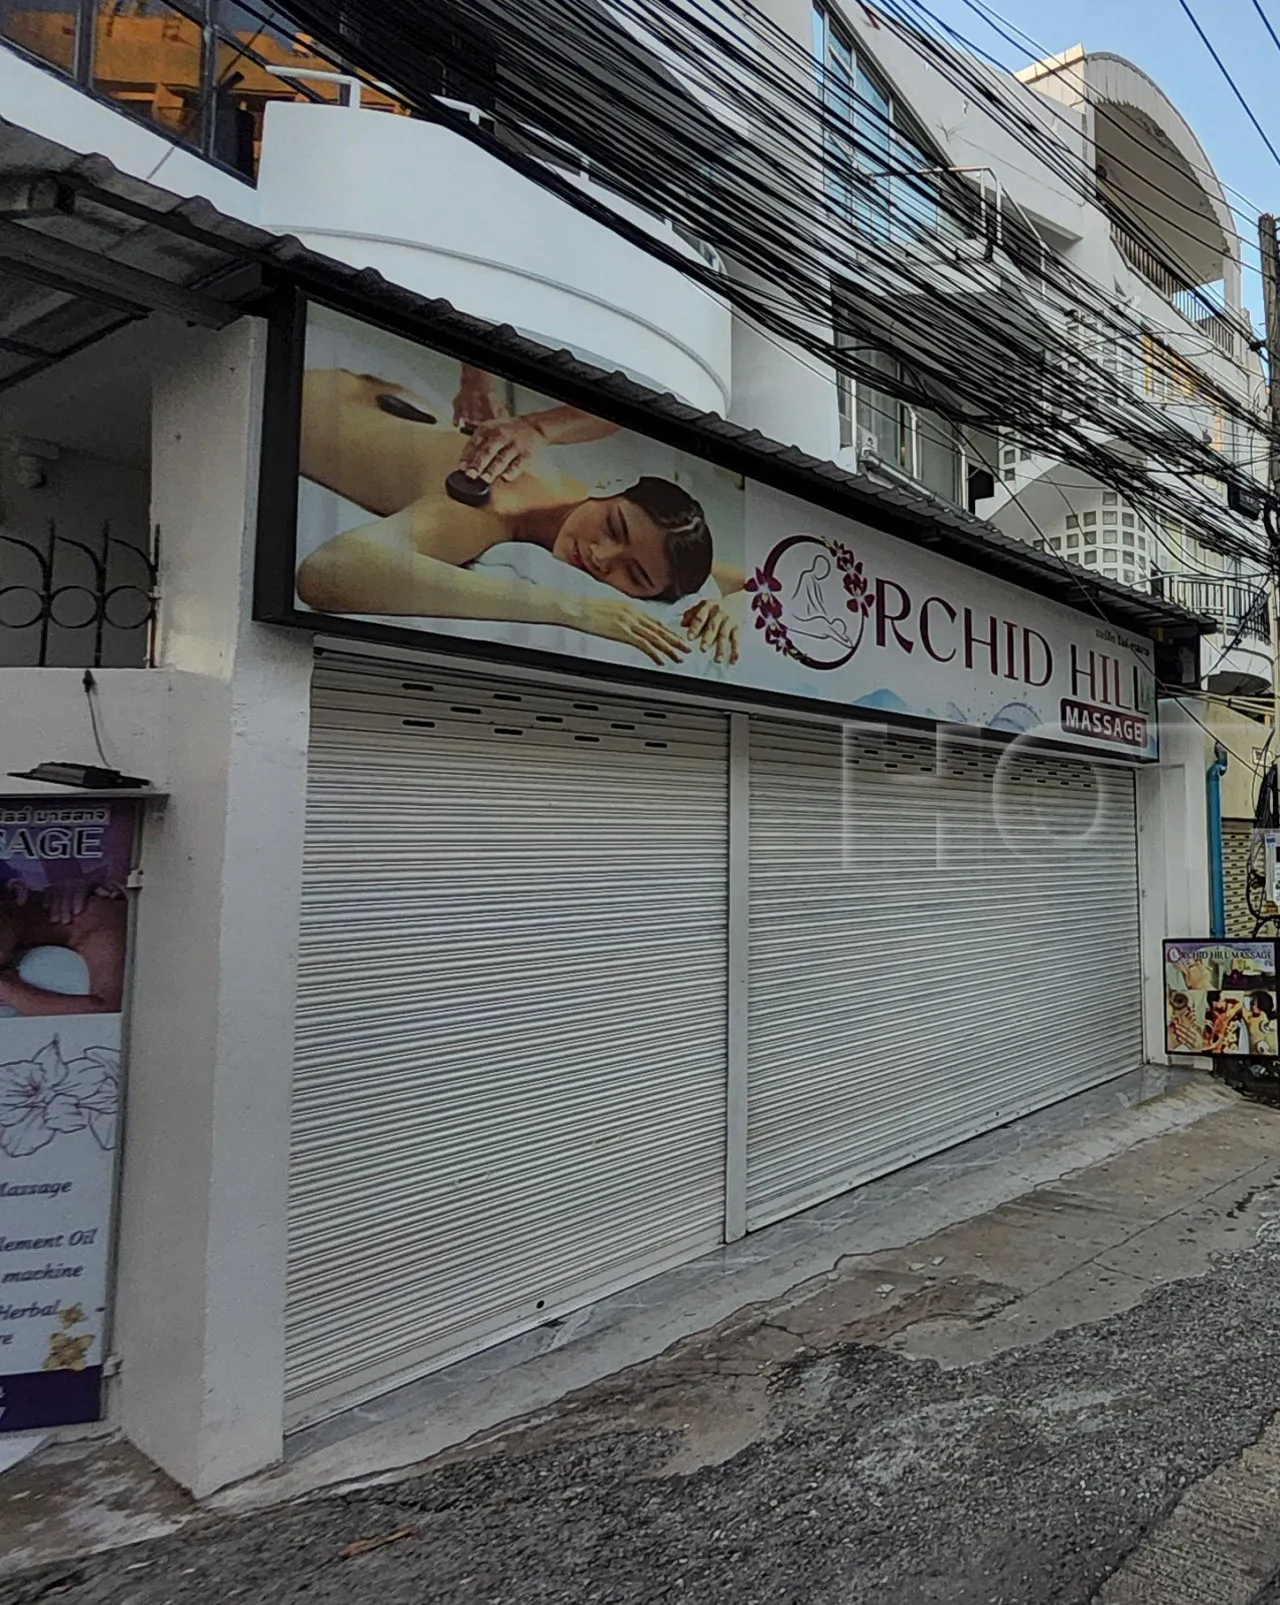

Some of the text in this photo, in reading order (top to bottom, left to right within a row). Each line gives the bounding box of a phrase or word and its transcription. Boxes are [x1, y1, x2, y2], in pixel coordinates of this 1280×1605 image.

[1069, 643, 1150, 712] HILL
[1065, 705, 1143, 742] MASSAGE
[69, 1227, 98, 1247] Oil
[2, 1262, 85, 1285] machine
